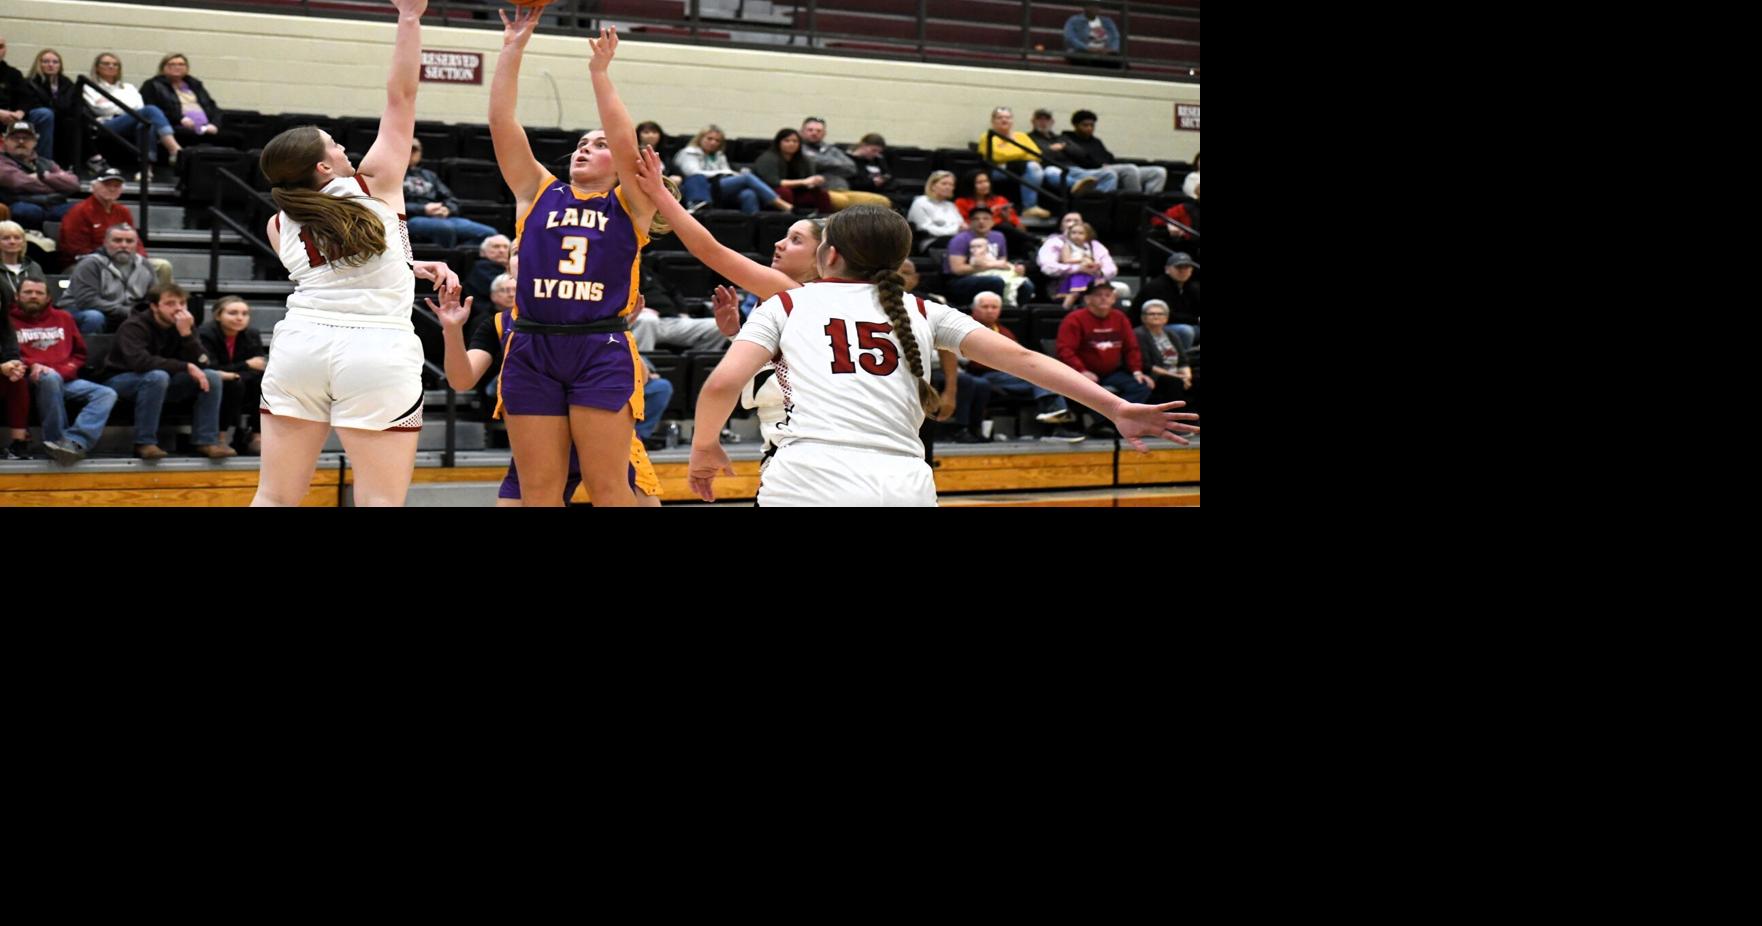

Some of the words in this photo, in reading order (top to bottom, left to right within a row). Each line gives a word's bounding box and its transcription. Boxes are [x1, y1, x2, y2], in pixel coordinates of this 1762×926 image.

[420, 53, 480, 68] RESERVED
[424, 66, 475, 81] SECTION
[545, 207, 610, 233] LADY
[558, 235, 588, 275] 3
[533, 278, 605, 302] LYONS
[824, 317, 899, 376] 15
